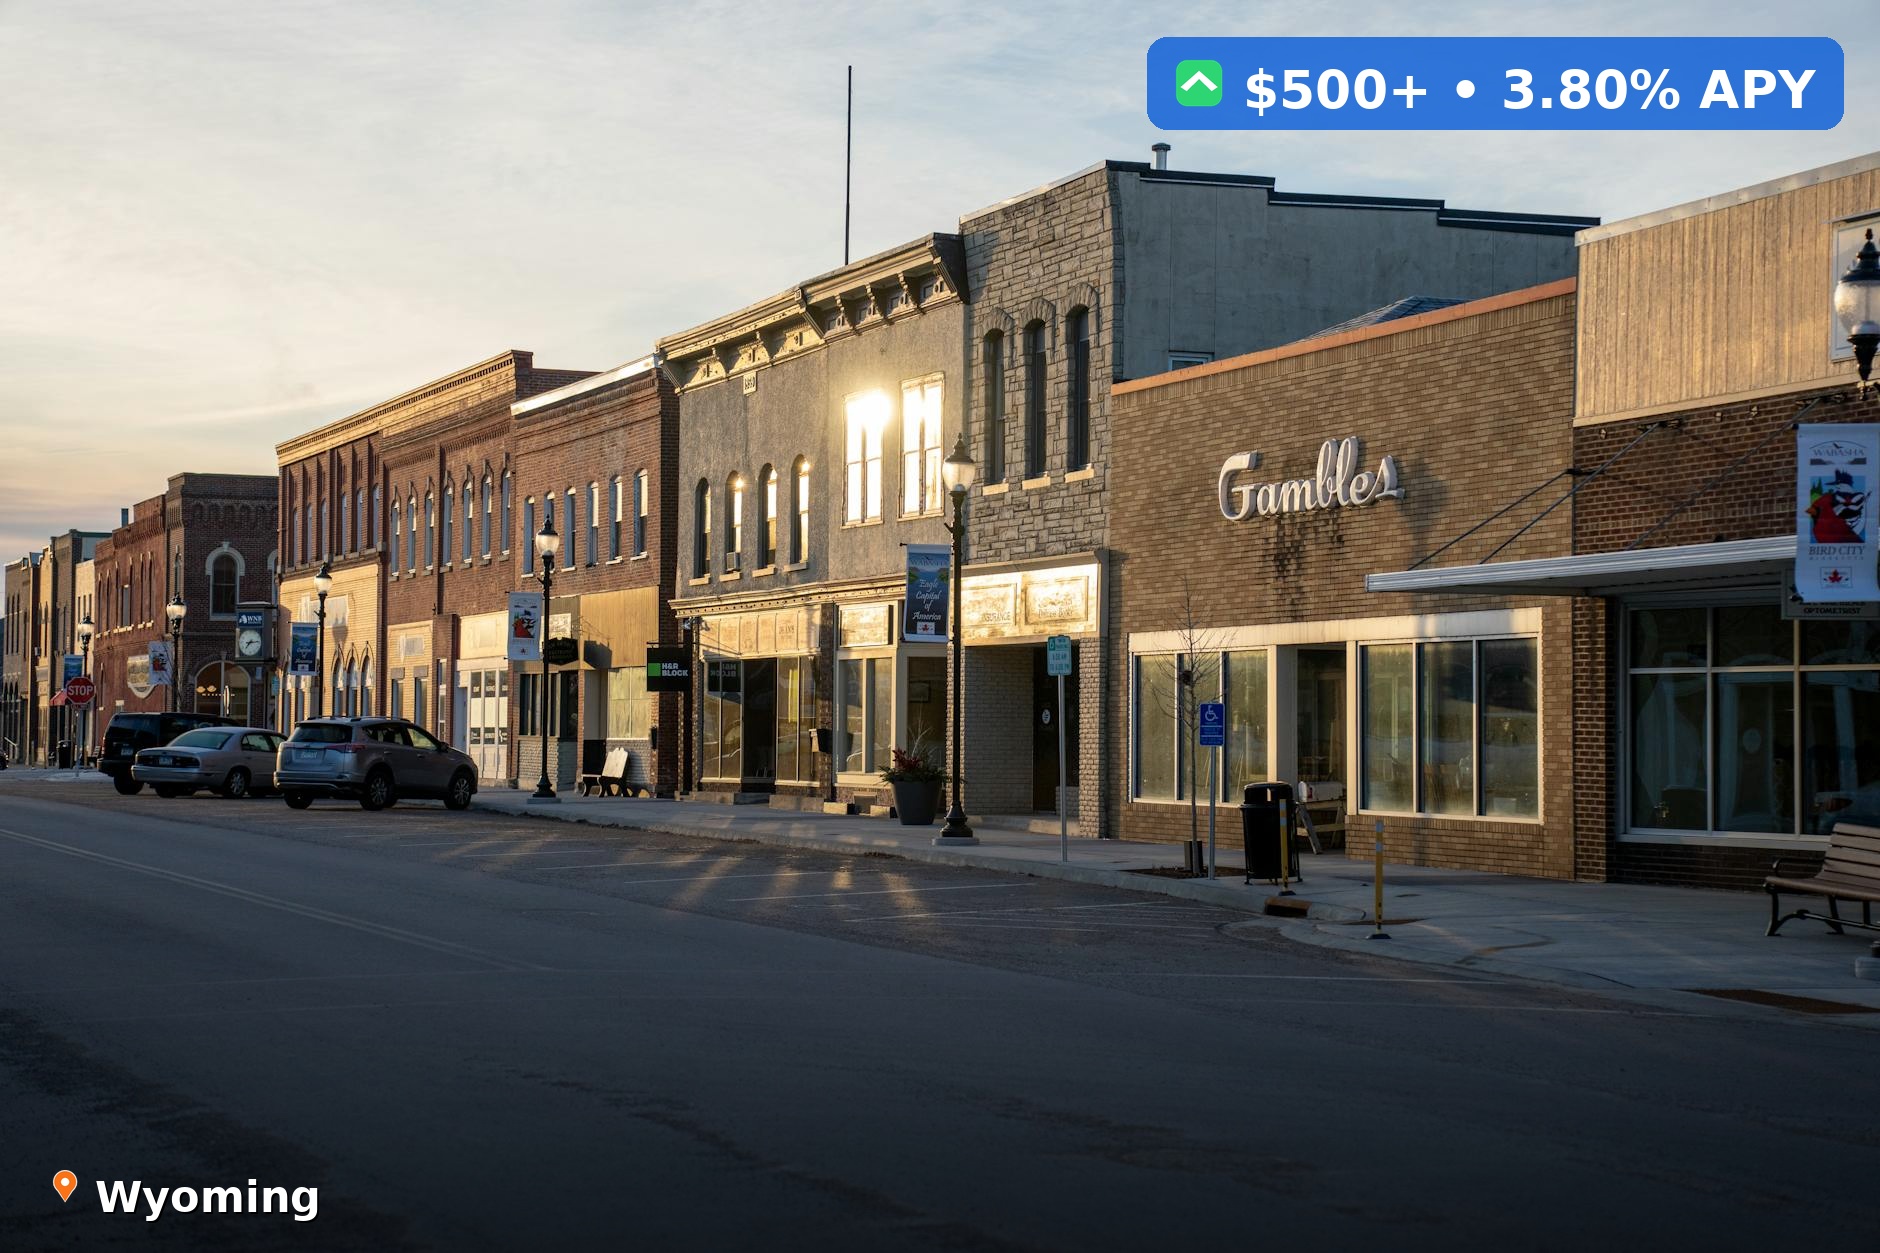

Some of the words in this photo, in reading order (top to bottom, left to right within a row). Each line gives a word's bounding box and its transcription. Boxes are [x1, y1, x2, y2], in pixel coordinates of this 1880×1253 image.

[1218, 436, 1404, 521] Gambles
[1809, 546, 1837, 555] BIRD
[1838, 546, 1865, 555] CITY
[919, 578, 939, 592] Eagle
[915, 590, 942, 604] Capital
[924, 599, 933, 611] of
[912, 611, 942, 621] America
[661, 662, 679, 670] H&R
[661, 669, 689, 677] BLOCK
[67, 685, 94, 696] STOP
